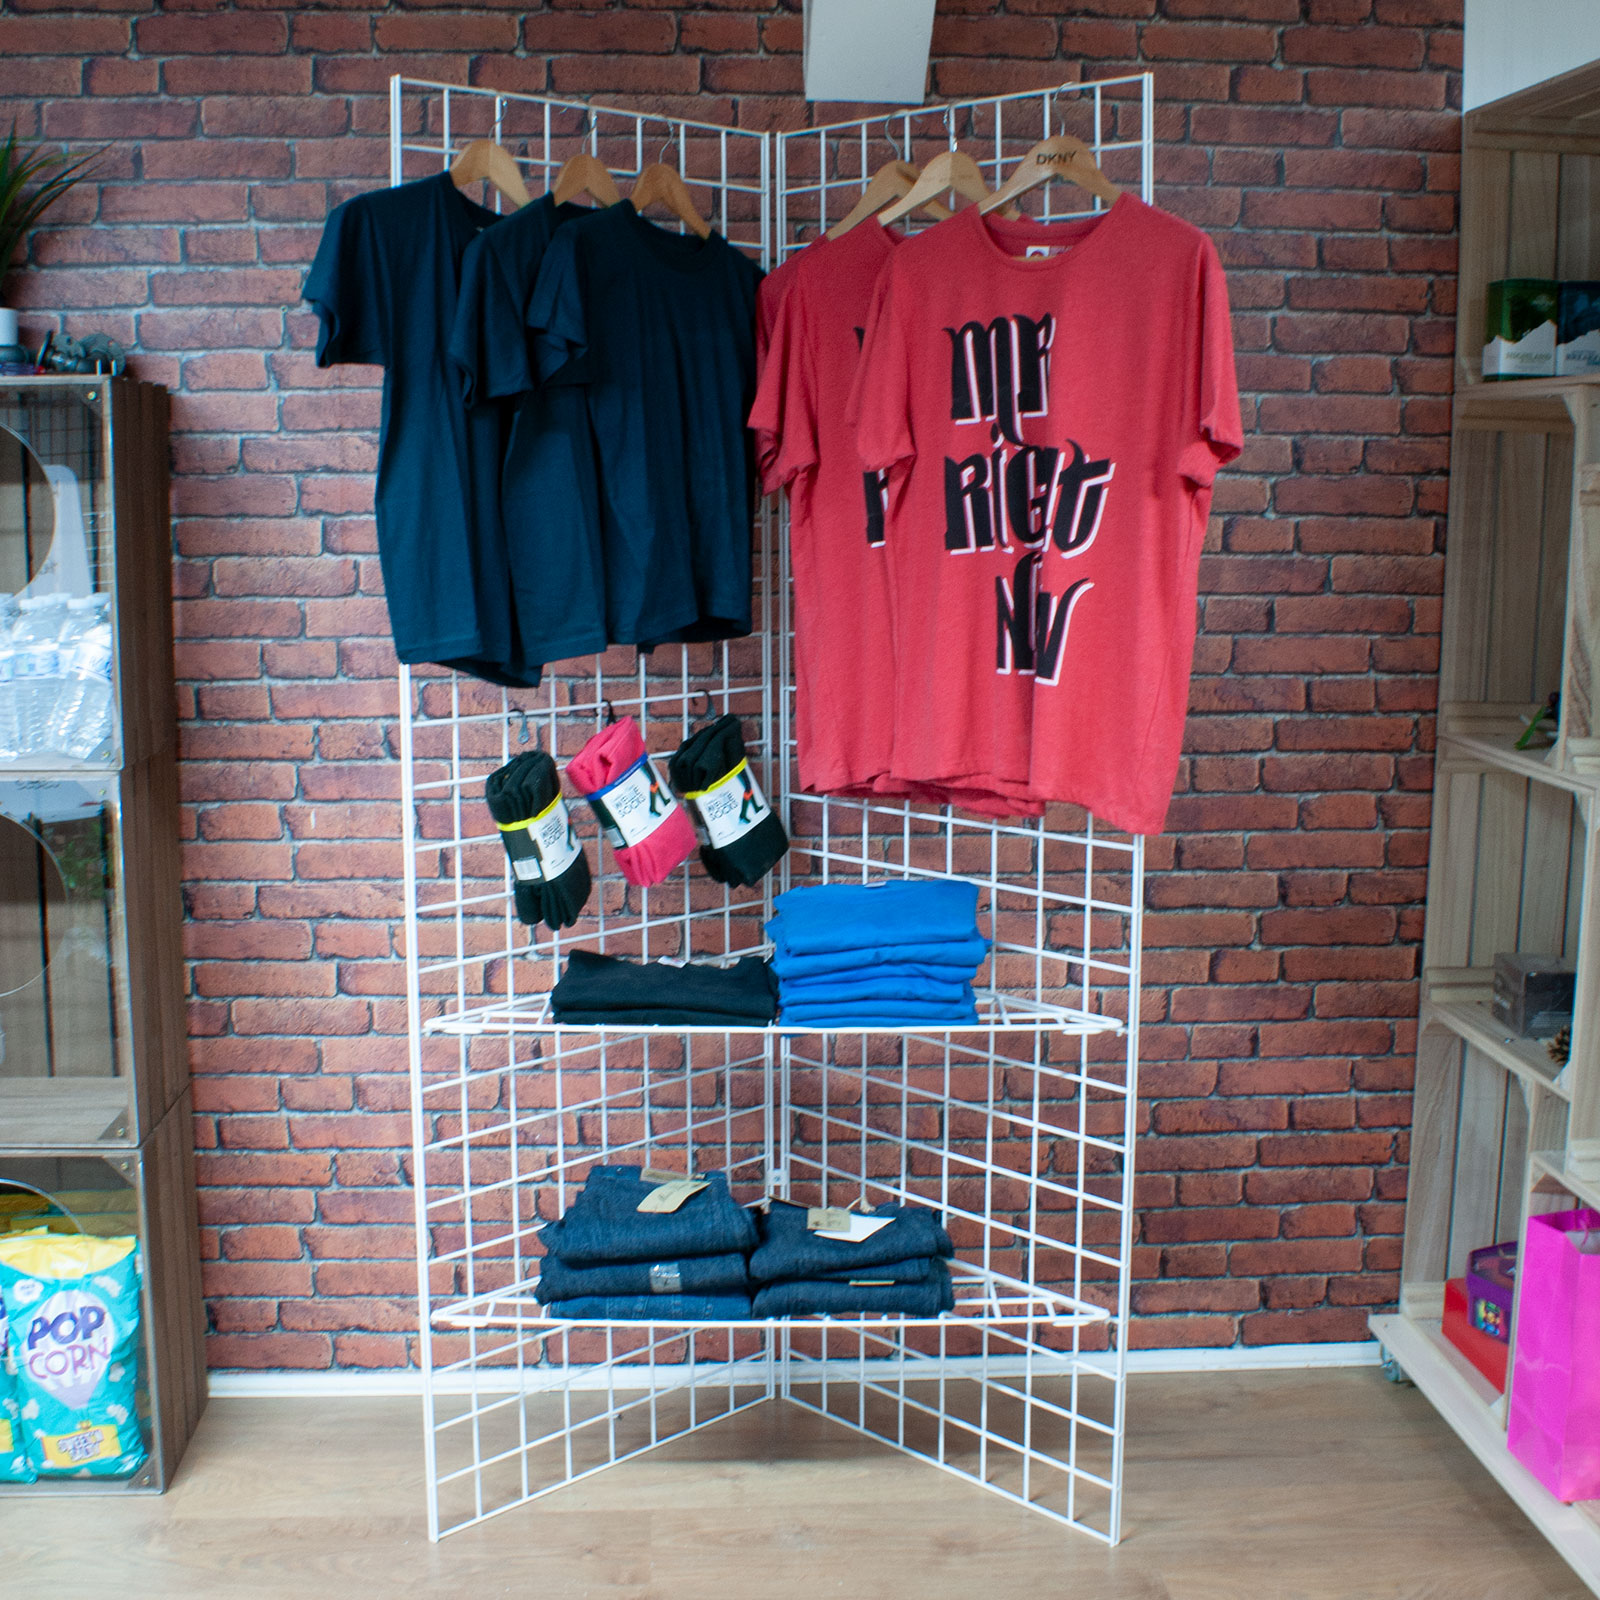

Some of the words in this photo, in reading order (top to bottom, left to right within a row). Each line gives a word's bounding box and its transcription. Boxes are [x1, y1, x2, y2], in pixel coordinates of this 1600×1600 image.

[1035, 150, 1077, 166] DKNY
[28, 1306, 105, 1351] POP
[29, 1337, 110, 1379] CORN
